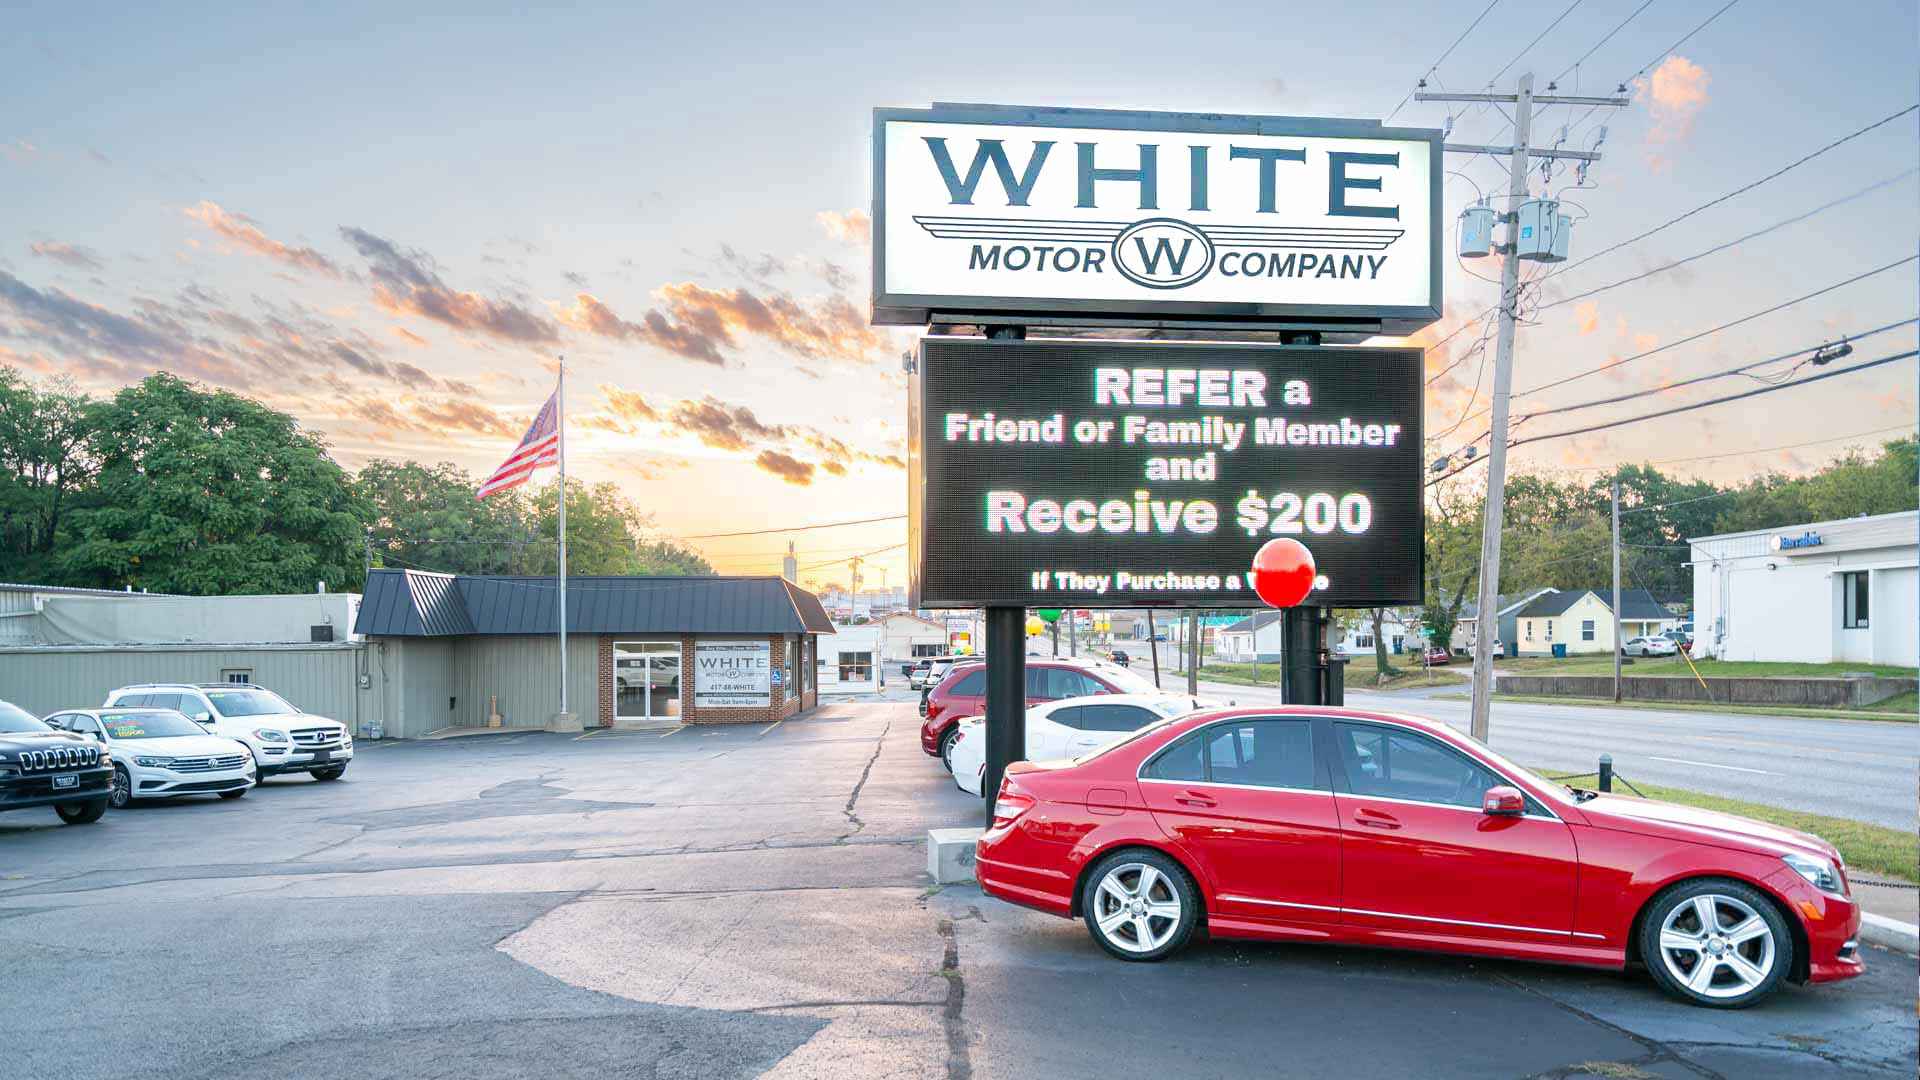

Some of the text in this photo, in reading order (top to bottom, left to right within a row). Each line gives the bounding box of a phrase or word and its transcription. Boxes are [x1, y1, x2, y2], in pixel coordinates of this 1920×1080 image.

[921, 136, 1400, 221] WHITE
[968, 236, 1388, 280] MOTOR W COMPANY
[1093, 367, 1312, 407] REFER a
[944, 412, 1400, 451] Friend or Family Member
[1144, 452, 1216, 481] and
[985, 488, 1372, 536] Receive $200
[1031, 571, 1050, 590] If
[1054, 571, 1111, 594] They
[1116, 571, 1220, 590] Purchase
[1225, 574, 1241, 590] a
[699, 657, 768, 668] WHITE
